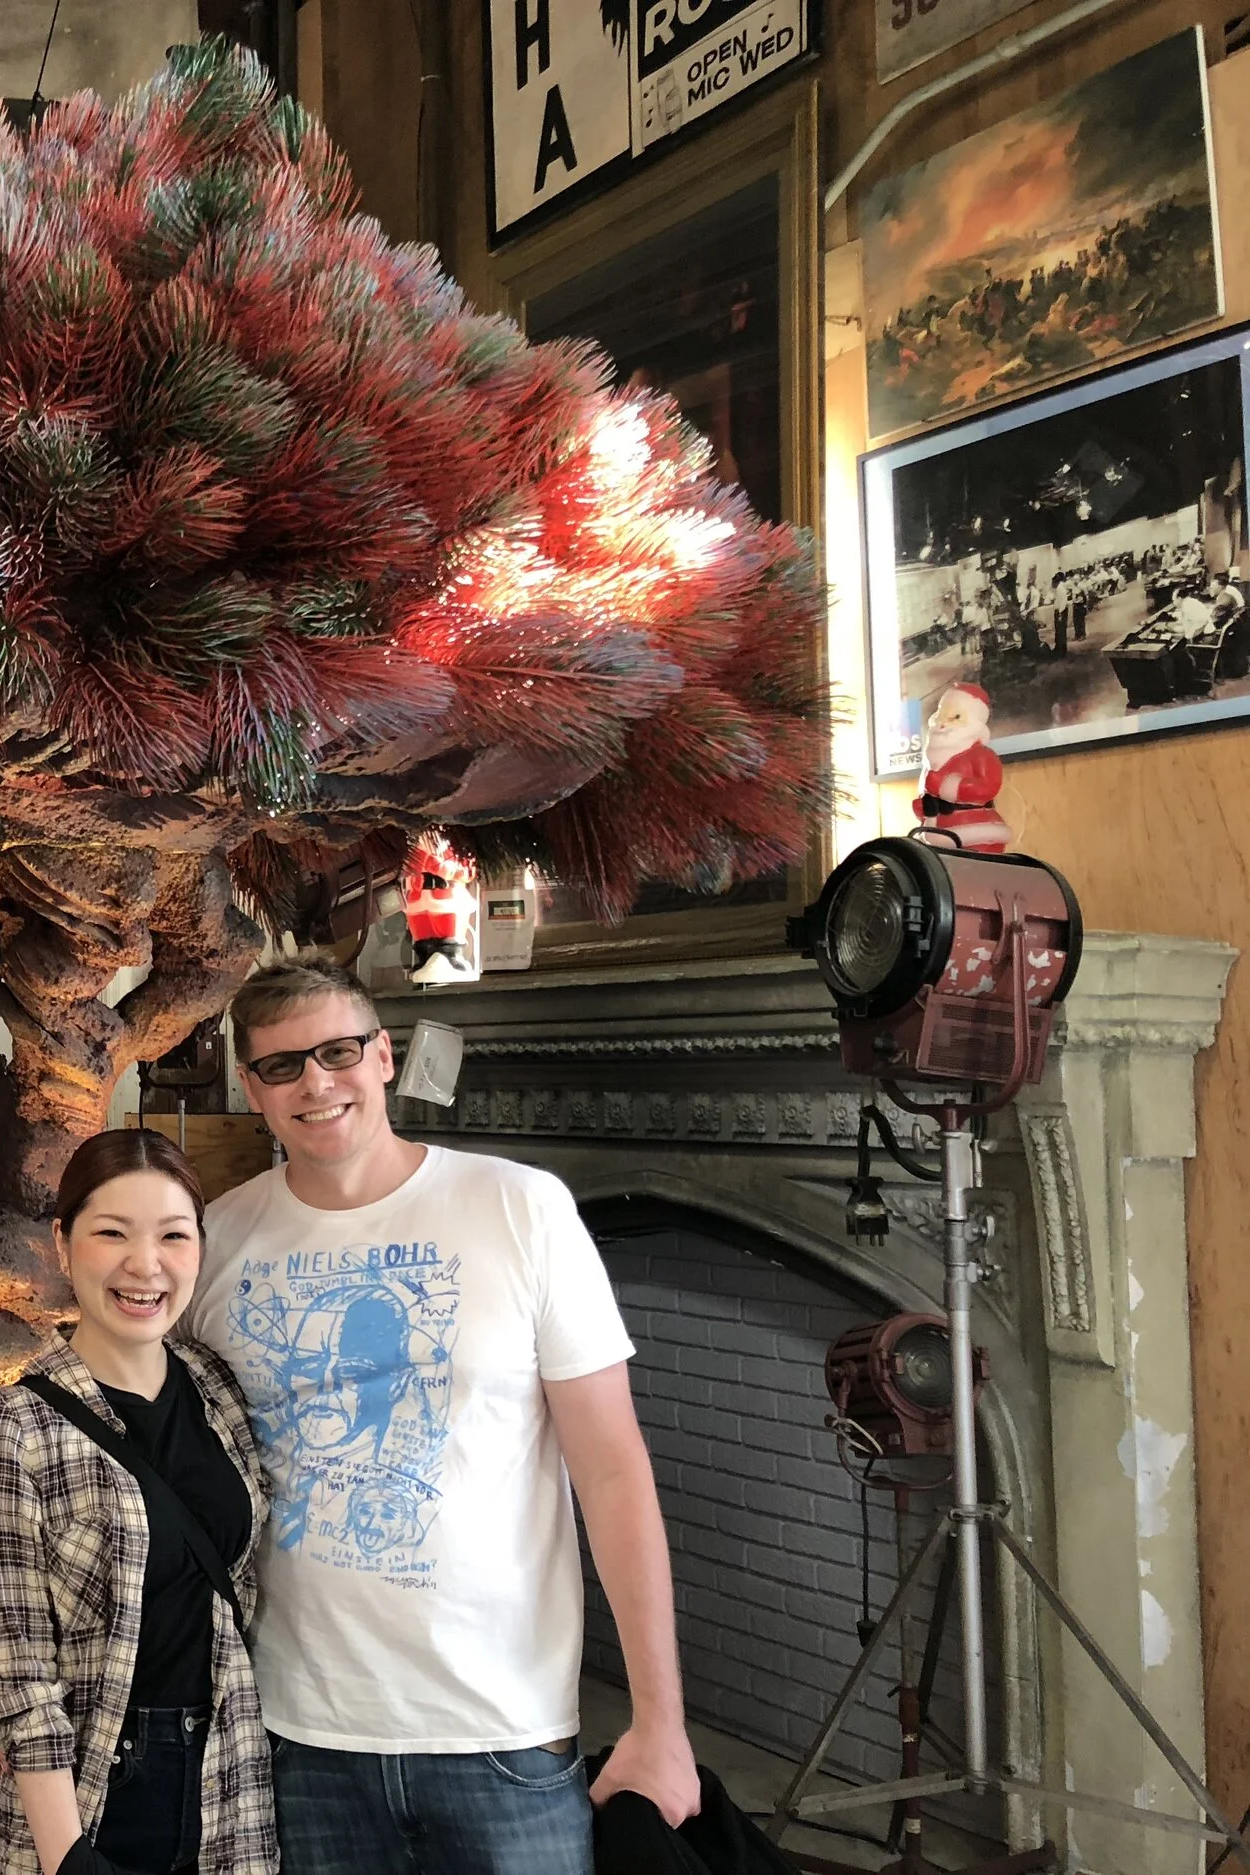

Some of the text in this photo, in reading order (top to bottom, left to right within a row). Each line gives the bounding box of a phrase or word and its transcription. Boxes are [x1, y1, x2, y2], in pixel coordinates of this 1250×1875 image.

[687, 29, 748, 83] OPEN
[687, 26, 795, 108] MIC WED
[889, 753, 922, 766] NEWS
[286, 1251, 351, 1276] NIELS
[367, 1241, 438, 1267] BOHR
